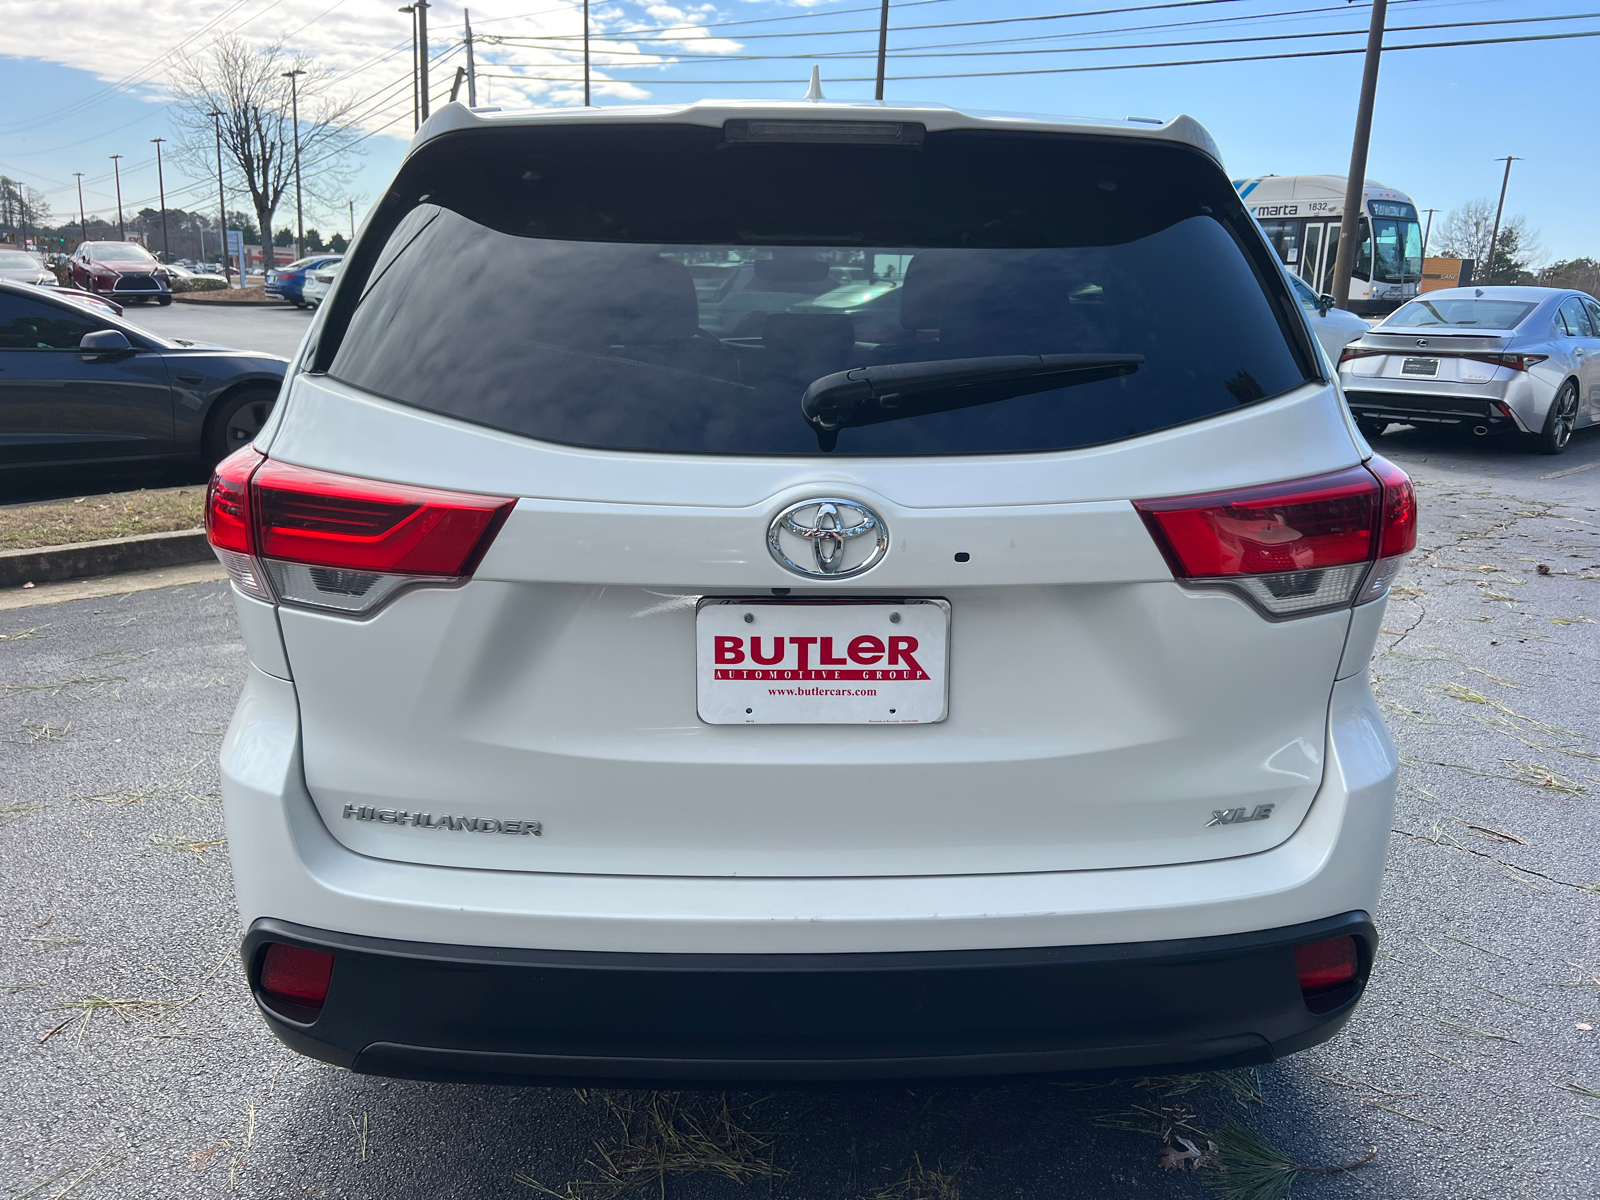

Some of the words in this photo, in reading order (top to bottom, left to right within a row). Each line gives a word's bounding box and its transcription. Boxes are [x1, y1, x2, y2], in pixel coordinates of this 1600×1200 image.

[1258, 205, 1298, 217] marta
[1308, 202, 1328, 212] 1832
[715, 670, 841, 679] AUTOMOTIVE
[862, 670, 923, 679] GROUP
[768, 687, 877, 696] www.butlercars.com
[342, 801, 543, 837] HIGHLANDER
[1204, 803, 1275, 827] XLE
